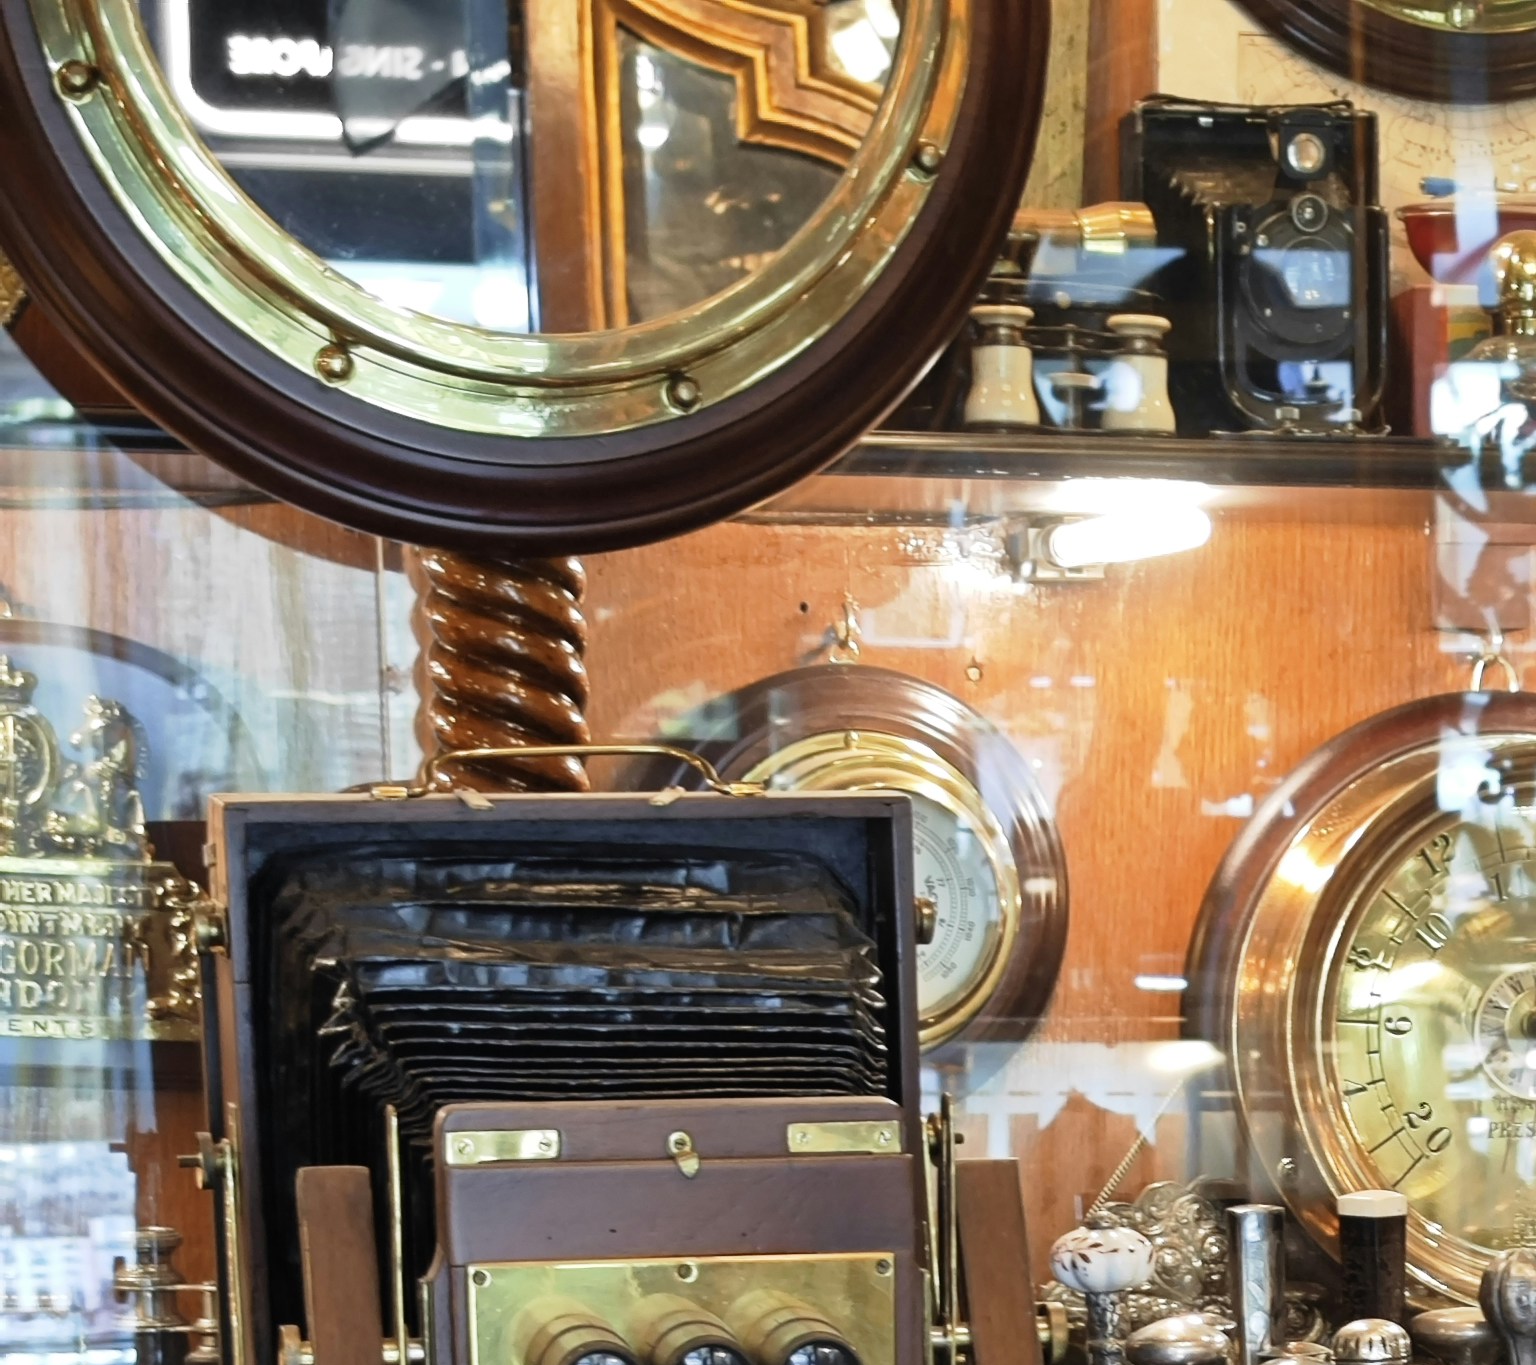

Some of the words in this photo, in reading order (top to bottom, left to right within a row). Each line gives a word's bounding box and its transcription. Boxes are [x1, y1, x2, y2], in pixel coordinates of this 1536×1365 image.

[1416, 832, 1456, 876] 12
[1415, 912, 1455, 957] 10
[1403, 1101, 1433, 1130] 2
[1426, 1126, 1453, 1154] 0
